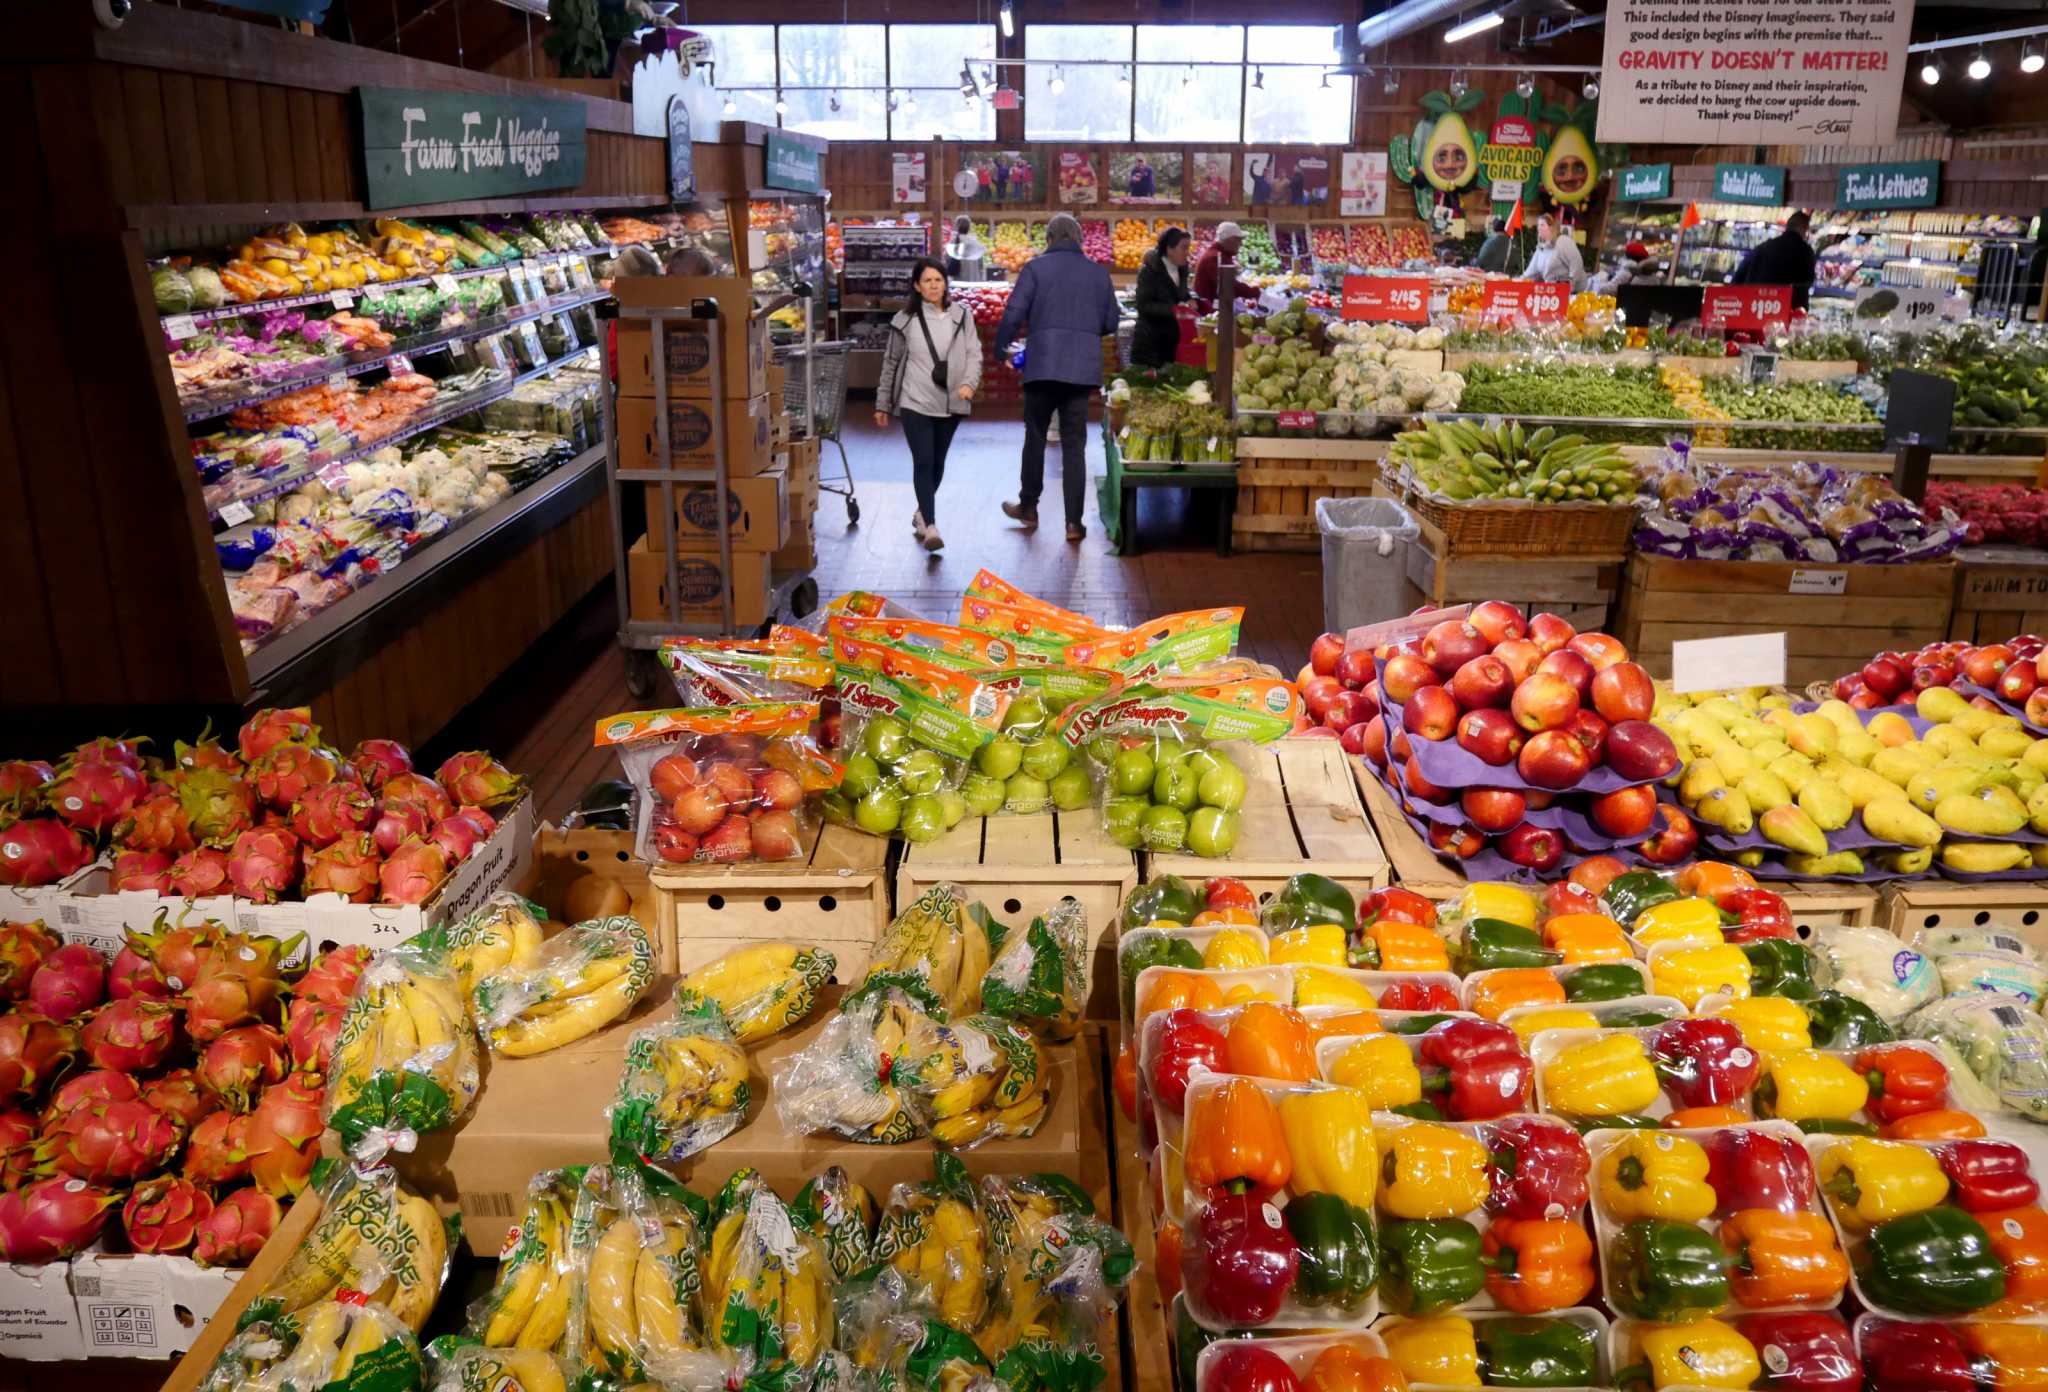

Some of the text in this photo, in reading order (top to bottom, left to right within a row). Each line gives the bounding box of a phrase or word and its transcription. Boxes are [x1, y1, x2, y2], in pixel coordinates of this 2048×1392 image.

[1624, 10, 1896, 26] This included the Disney Imagineers. They said
[1630, 28, 1883, 43] good design begins with the premise that...
[1619, 47, 1889, 71] GRAVITY DOESN'T MATTER!
[1635, 80, 1868, 94] As a tribute to Disney and their inspiration,
[1640, 94, 1860, 108] we decided to hang the cow upside down.
[1697, 109, 1800, 123] Thank you Disney!"
[401, 107, 561, 178] Farm Fresh Veggies
[1481, 146, 1542, 165] AVOCADO
[1489, 163, 1529, 180] GIRLS
[1878, 173, 1929, 201] Lettuce
[448, 875, 482, 920] Dragon
[483, 847, 503, 880] Fruit
[0, 1309, 22, 1317] agon
